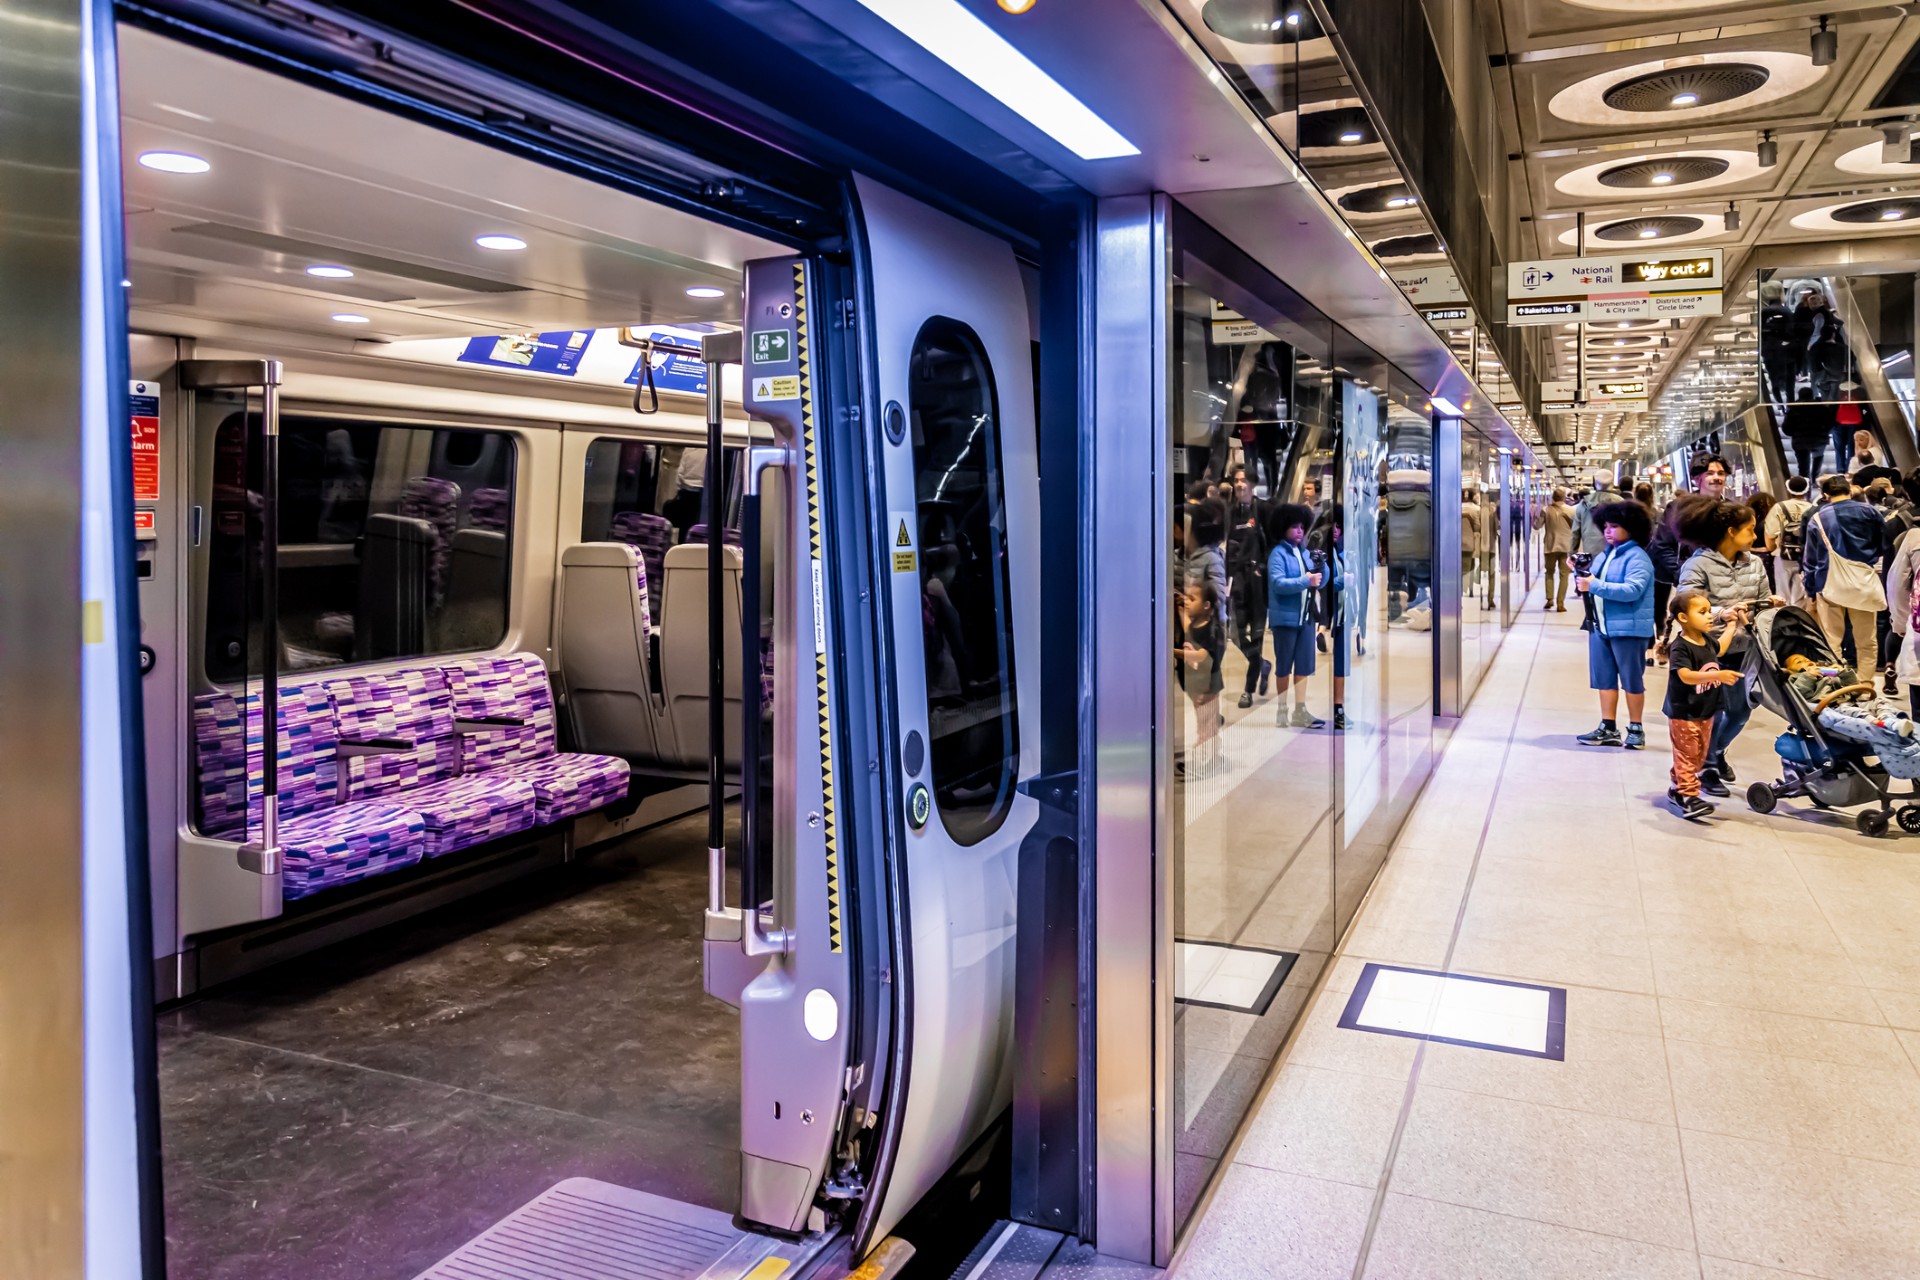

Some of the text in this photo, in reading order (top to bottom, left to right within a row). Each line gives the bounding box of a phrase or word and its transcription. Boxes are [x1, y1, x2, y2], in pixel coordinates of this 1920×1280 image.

[1572, 265, 1613, 276] National
[1638, 264, 1695, 280] Way out
[1595, 275, 1613, 284] Rail
[1593, 299, 1641, 308] Hammersmith
[1655, 296, 1695, 305] District and
[1524, 305, 1565, 315] Bakerloo line
[1611, 306, 1626, 315] City
[1626, 305, 1640, 313] line
[755, 353, 769, 361] Exit
[132, 441, 154, 450] larm
